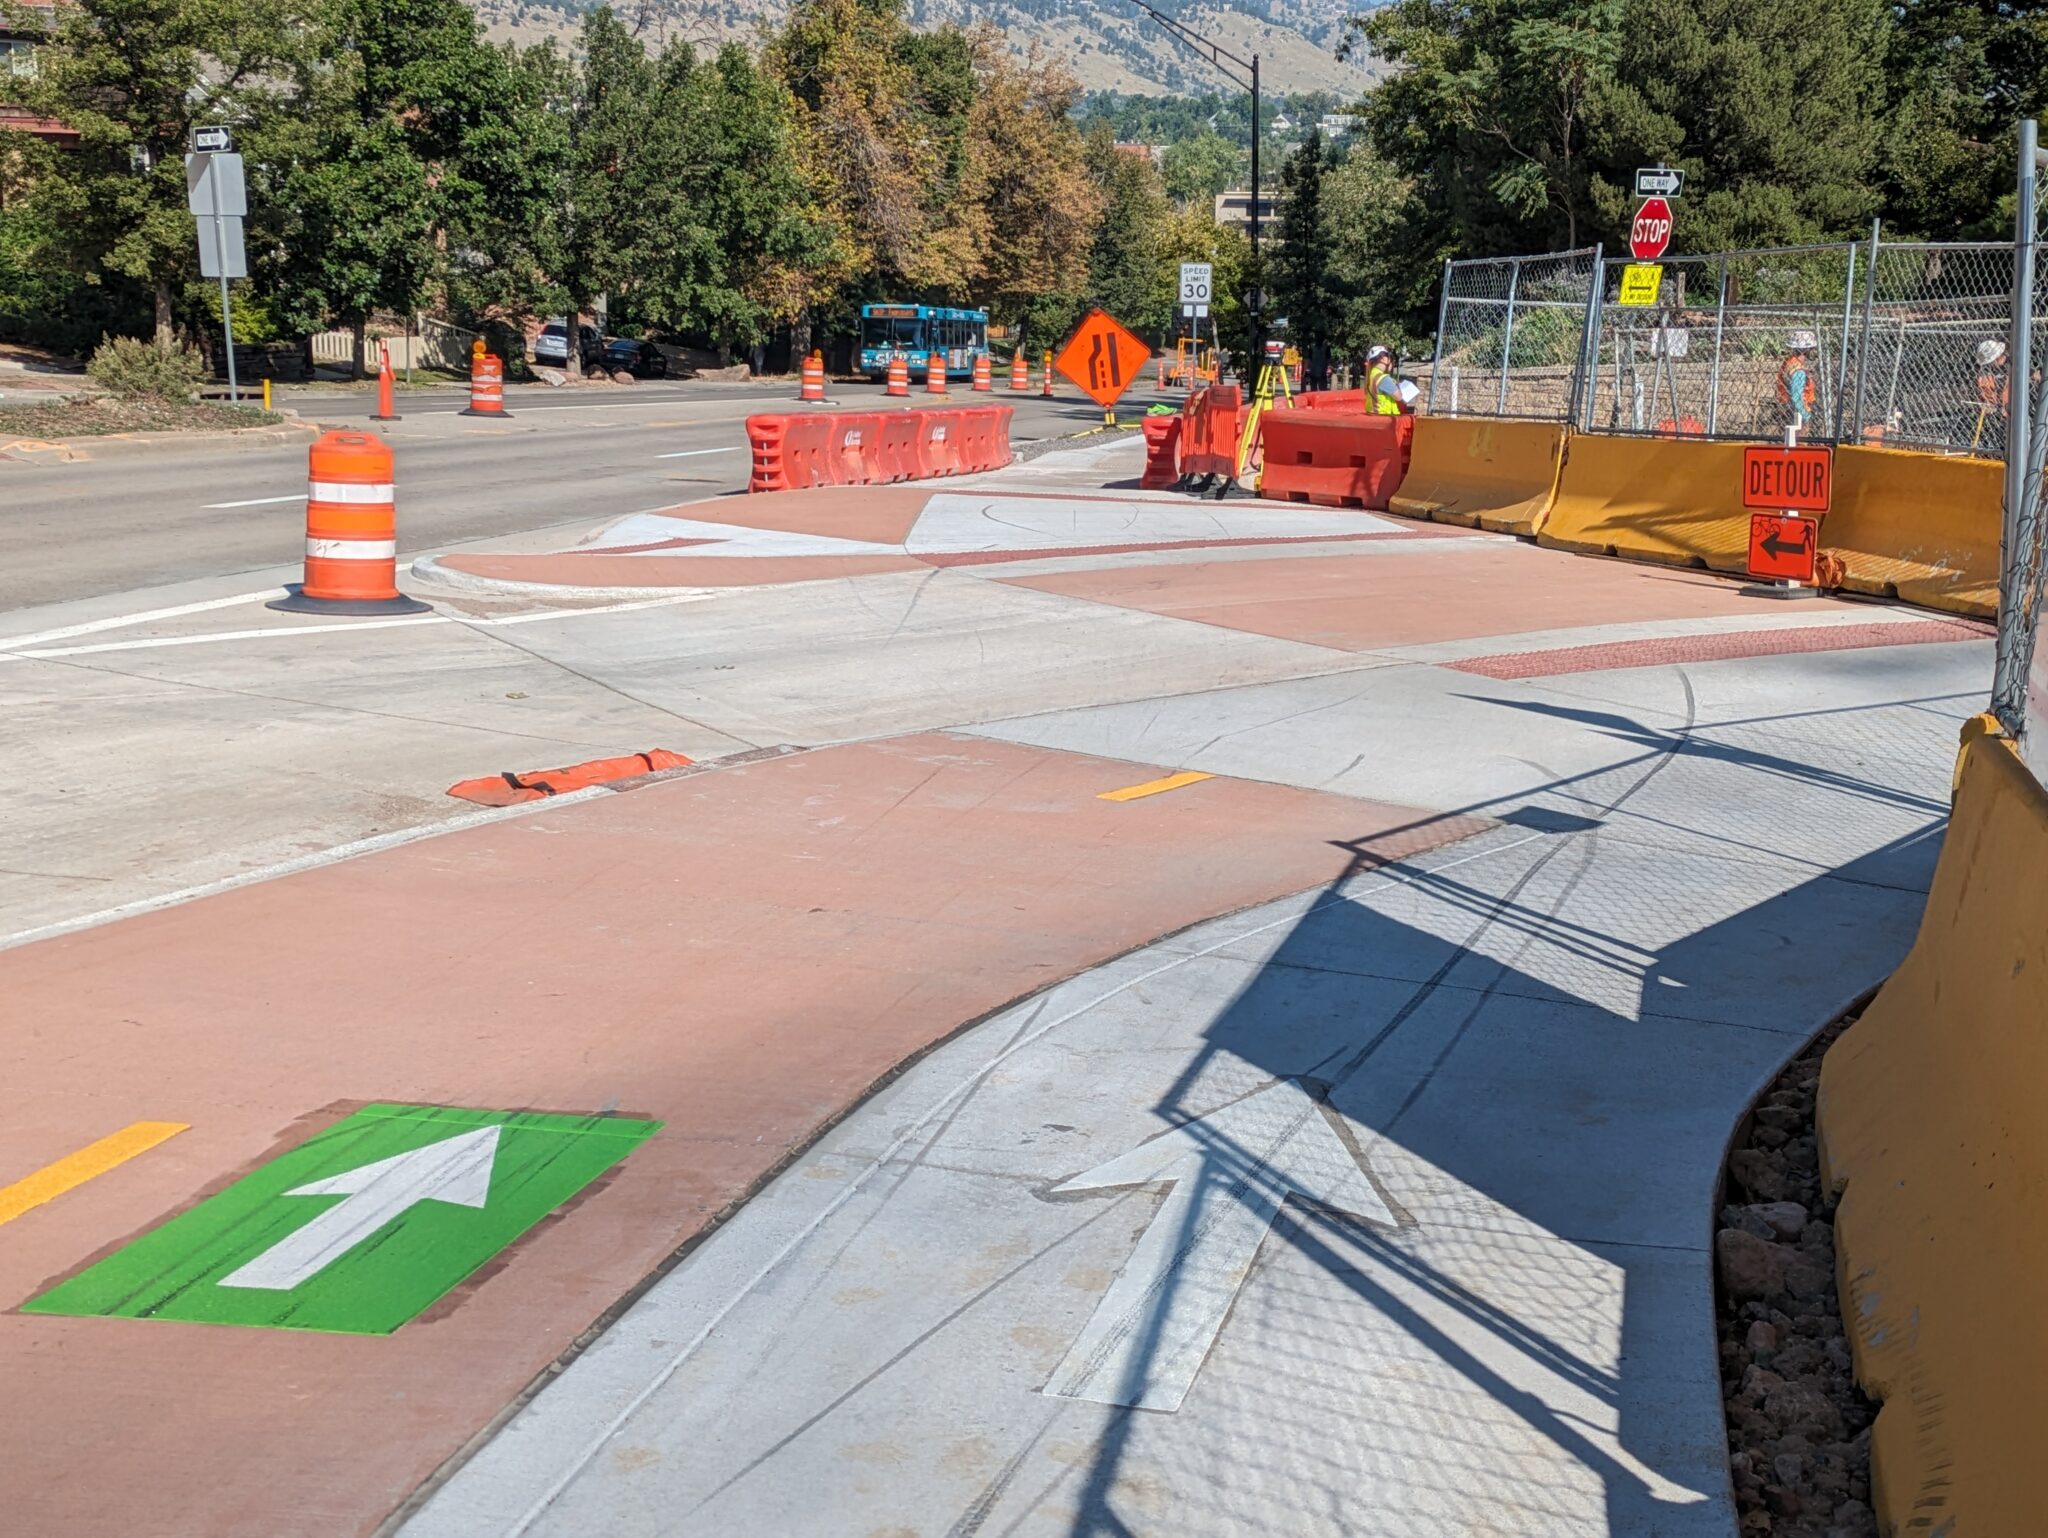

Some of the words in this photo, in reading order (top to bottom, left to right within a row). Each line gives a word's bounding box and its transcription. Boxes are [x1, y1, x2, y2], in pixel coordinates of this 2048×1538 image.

[199, 135, 209, 145] ONE
[210, 134, 220, 144] WAY
[1642, 177, 1656, 188] ONE
[1656, 177, 1670, 189] WAY
[1633, 218, 1669, 243] STOP
[1183, 267, 1209, 275] SPEED
[1183, 283, 1208, 298] 30
[1750, 460, 1825, 498] DETOUR
